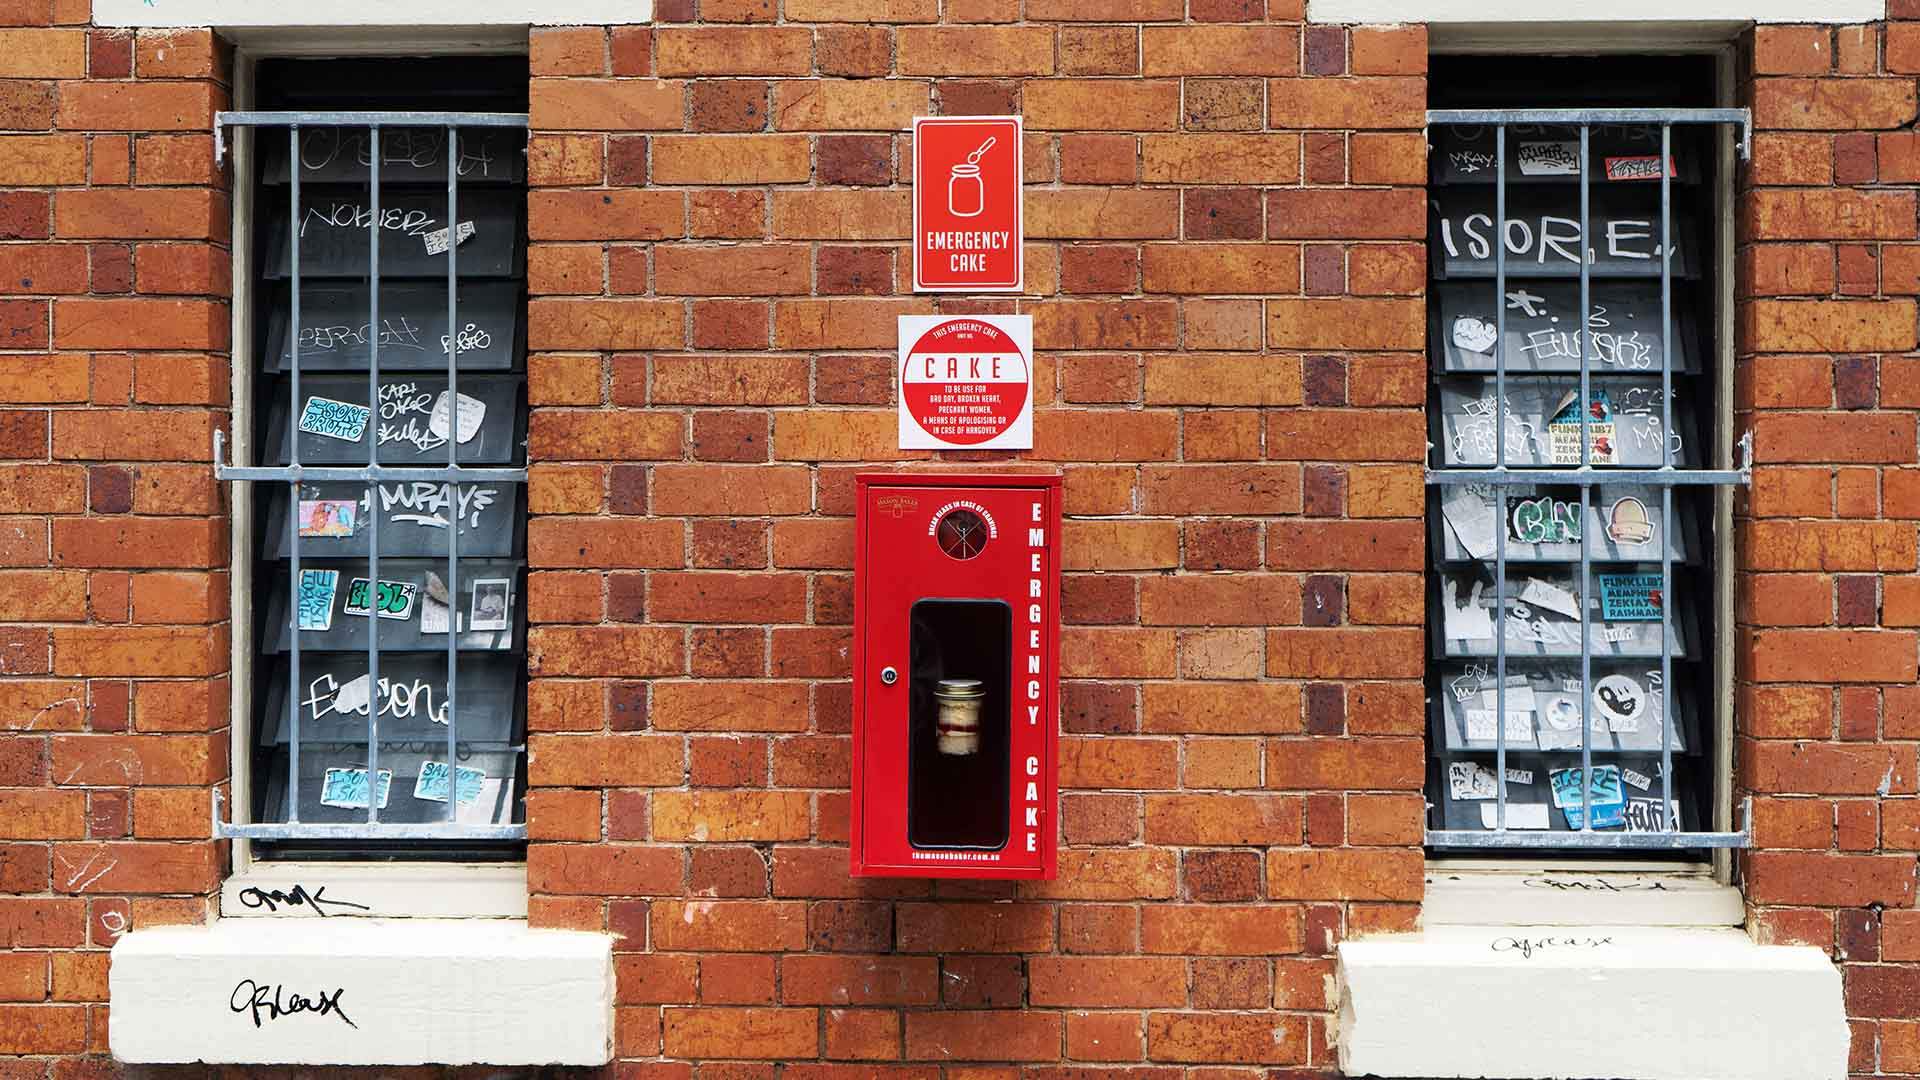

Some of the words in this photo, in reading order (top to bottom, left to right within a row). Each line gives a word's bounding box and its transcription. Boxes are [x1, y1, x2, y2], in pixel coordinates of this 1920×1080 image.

[927, 231, 1009, 249] EMERGENCY
[950, 254, 987, 272] CAKE
[933, 327, 947, 340] THIS
[947, 323, 982, 333] EMERGENCY
[983, 327, 998, 340] CAKE
[925, 357, 1000, 379] CAKE
[944, 385, 952, 393] TO
[954, 385, 961, 393] BE
[963, 385, 974, 393] USE
[975, 385, 987, 393] FOR
[930, 394, 942, 403] BAD
[957, 394, 981, 403] BROKEN
[938, 405, 968, 414] PREGNANT
[969, 405, 993, 415] WOMEN,
[301, 413, 363, 438] BRUTO
[922, 416, 928, 424] A
[929, 416, 948, 424] MEANS
[950, 416, 957, 424] OF
[958, 416, 997, 424] APOLOGISING
[998, 416, 1007, 424] OR
[933, 426, 939, 434] IN
[941, 426, 955, 434] CASE
[957, 426, 964, 434] OF
[965, 426, 998, 434] HANGOVER.
[936, 503, 954, 518] GLASS
[952, 500, 960, 508] IN
[960, 500, 976, 509] CASE
[975, 505, 984, 513] OF
[982, 510, 998, 539] CRAVINGS
[1027, 503, 1044, 725] EMERGENCY
[1025, 756, 1038, 852] CAKE
